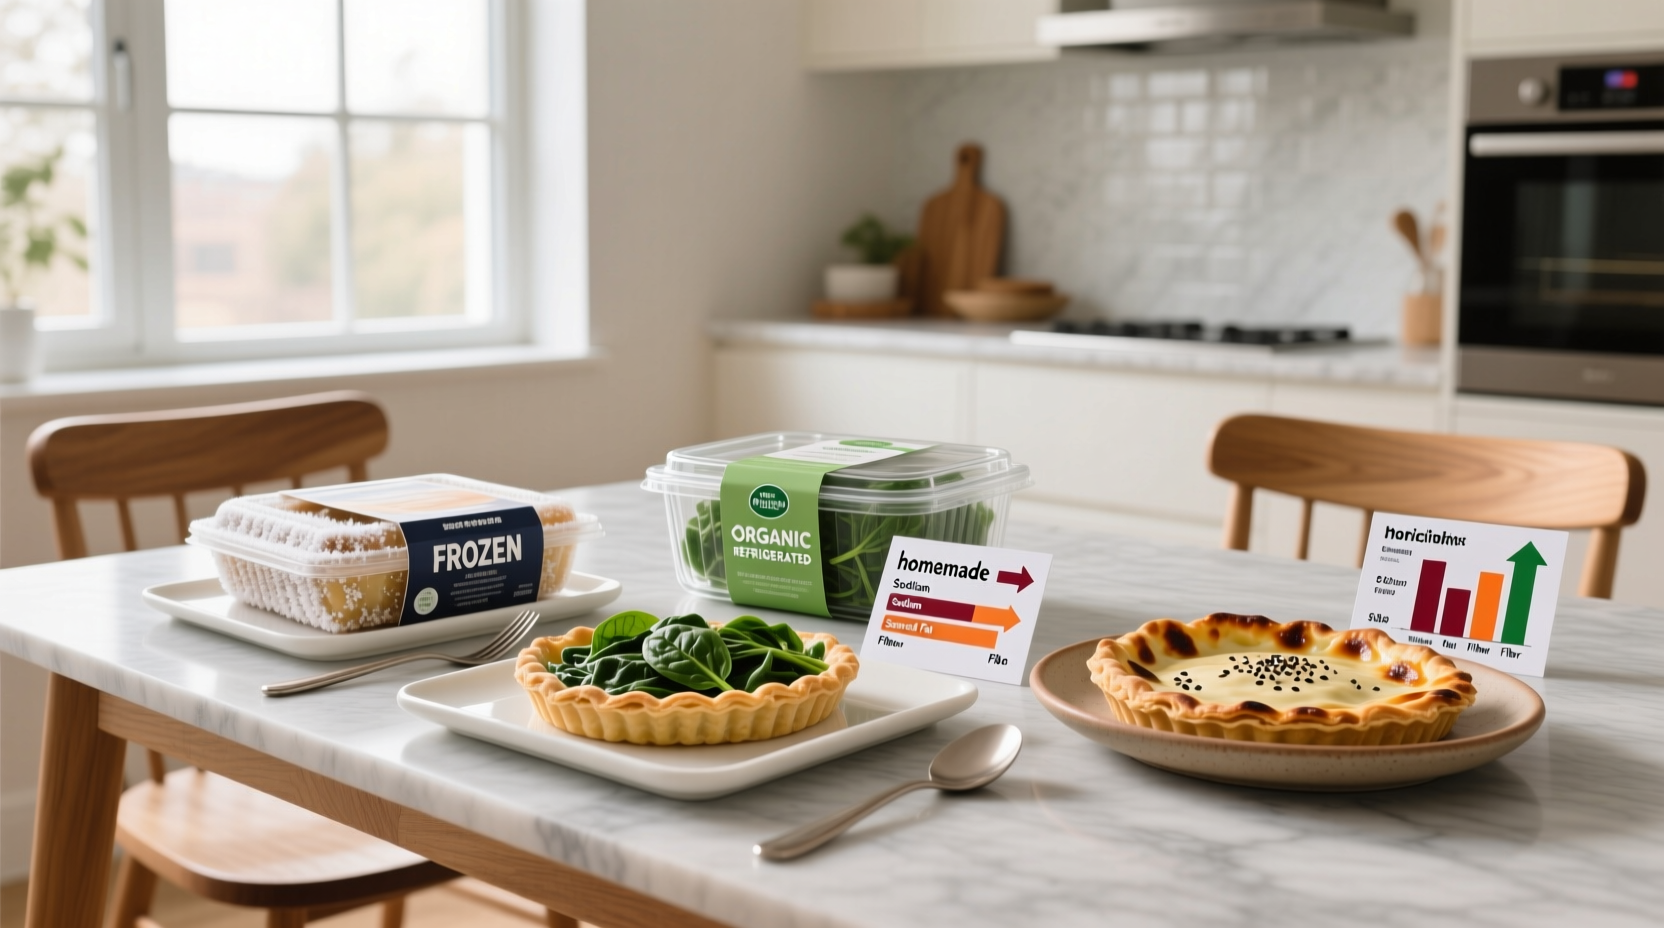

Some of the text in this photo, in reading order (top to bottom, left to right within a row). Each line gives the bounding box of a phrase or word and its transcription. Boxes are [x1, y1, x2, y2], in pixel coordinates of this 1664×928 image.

[731, 524, 811, 549] ORGANIC
[433, 534, 522, 573] FROZEN
[733, 546, 812, 565] REFRIGERATED
[897, 550, 990, 581] homemade
